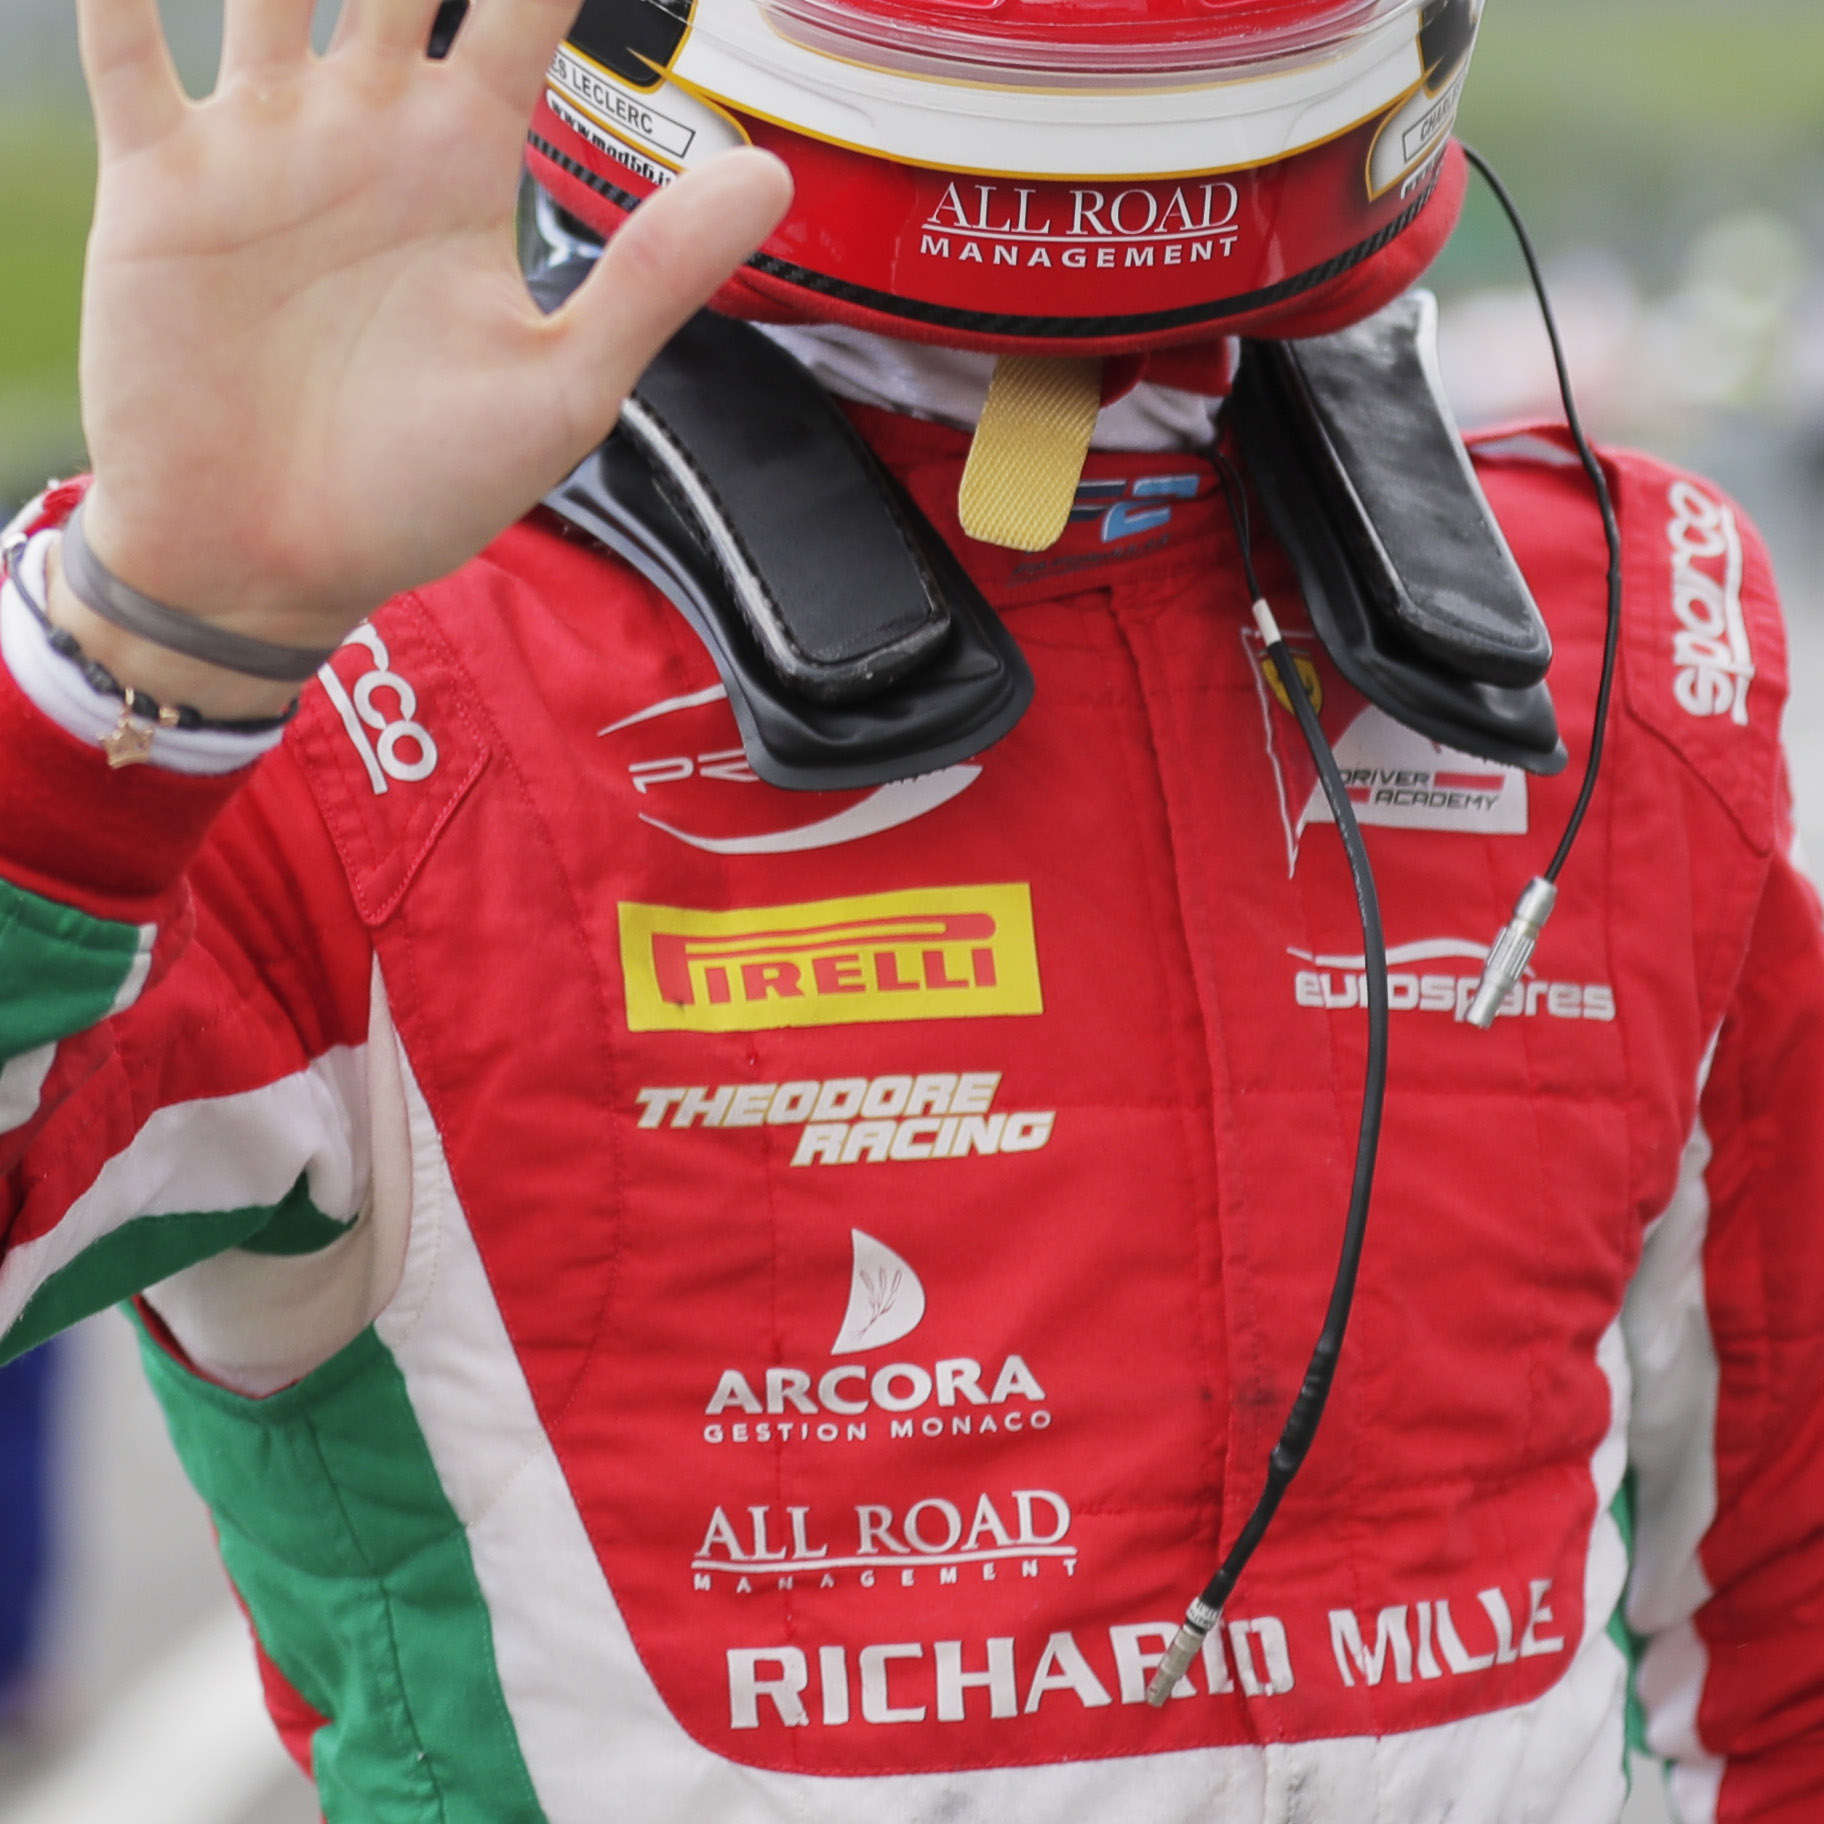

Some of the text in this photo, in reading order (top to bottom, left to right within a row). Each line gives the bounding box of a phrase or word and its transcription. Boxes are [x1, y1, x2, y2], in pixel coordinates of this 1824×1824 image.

[572, 69, 654, 135] LECLERC
[927, 181, 1239, 235] ALL ROAD
[920, 234, 1238, 269] MANAGEMENT
[1666, 480, 1754, 725] sparco
[1339, 767, 1430, 786] DRIVER
[1373, 787, 1500, 812] ACADEMY
[650, 912, 997, 1006] PIRELLI
[635, 1071, 1003, 1129] THEODORE
[789, 1110, 1057, 1168] RACING
[704, 1354, 1047, 1416] ARCORA
[703, 1409, 1052, 1445] GESTION MONACO
[693, 1488, 1072, 1562] ALL ROAD
[692, 1558, 1078, 1594] MANAGEMENT
[726, 1578, 1565, 1730] RICHARD MILLE
